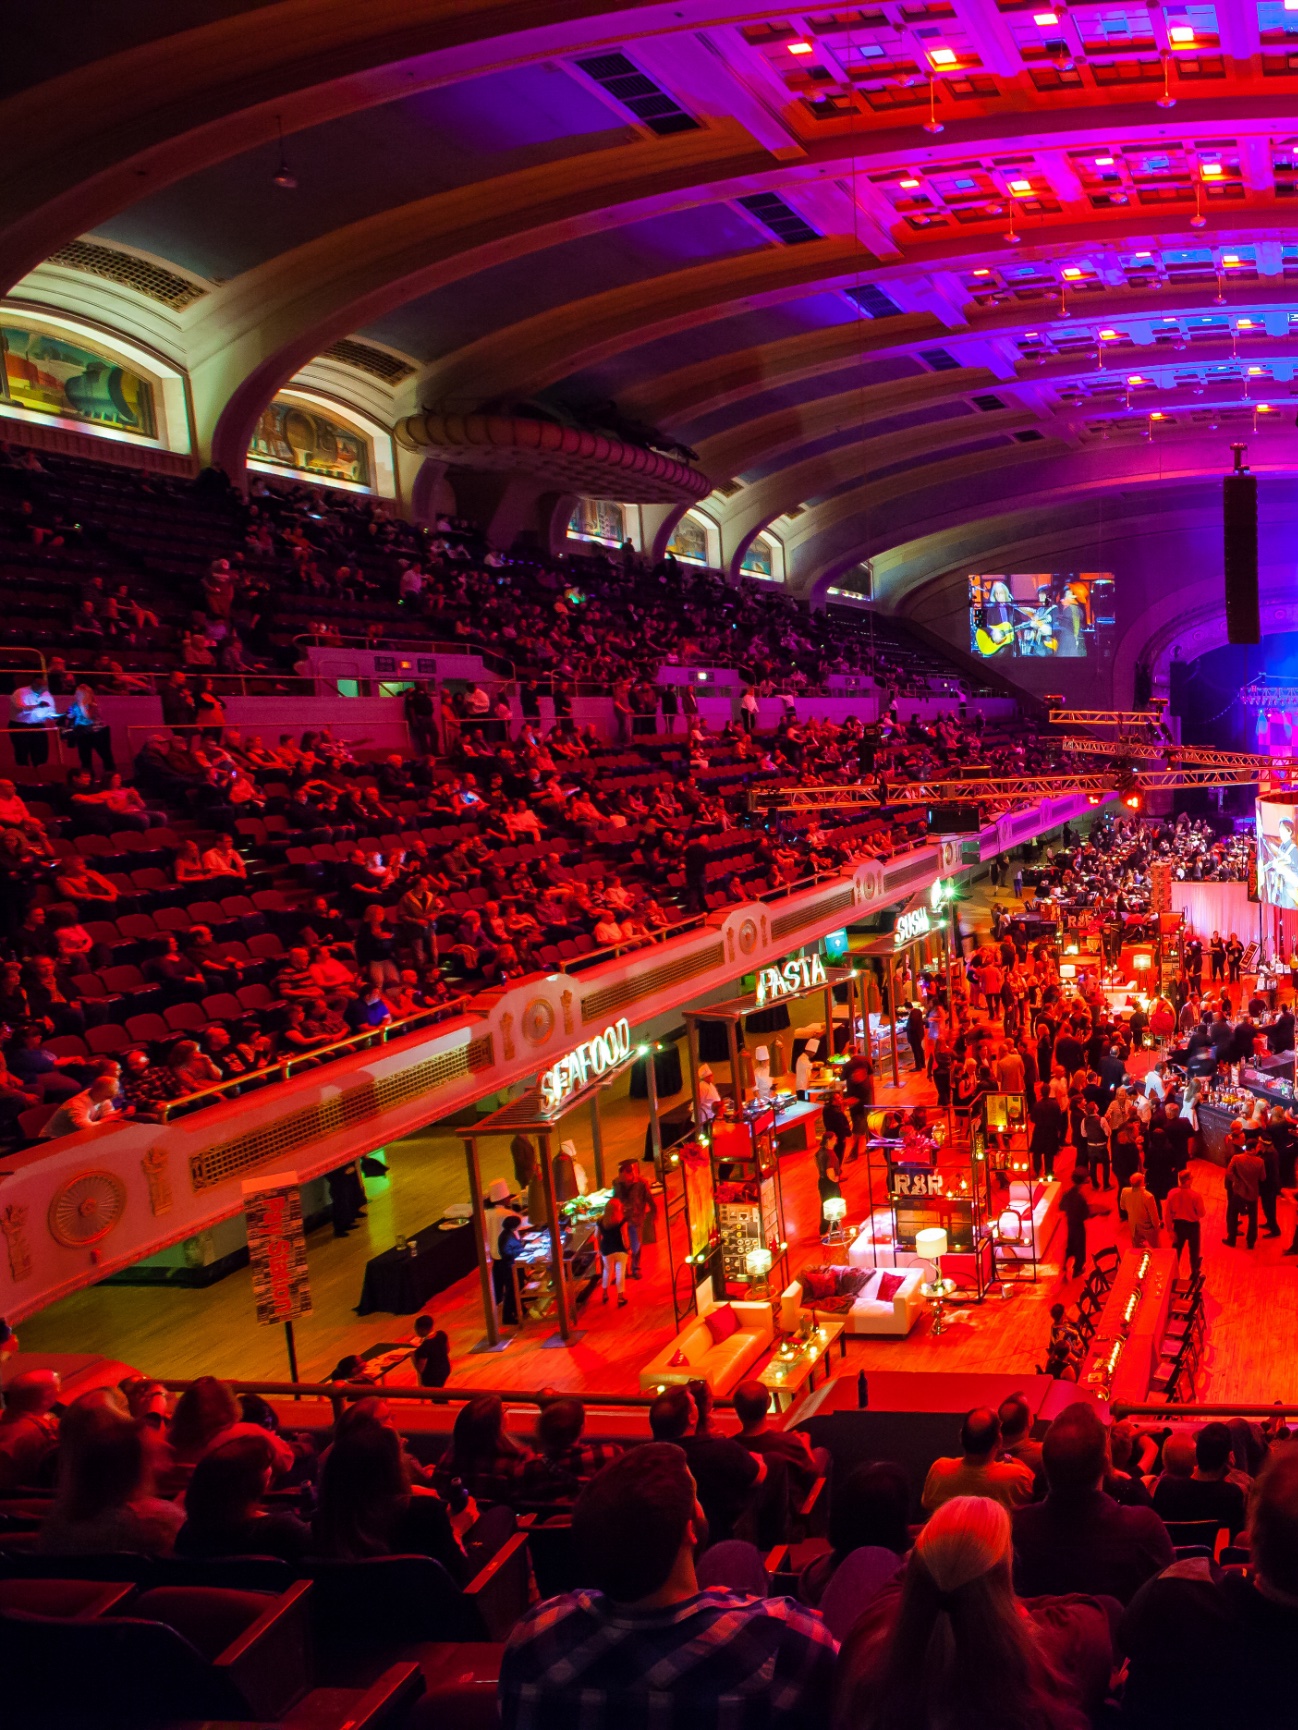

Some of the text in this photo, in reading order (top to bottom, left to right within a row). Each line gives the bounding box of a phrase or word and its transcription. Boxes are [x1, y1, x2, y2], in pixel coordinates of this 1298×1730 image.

[756, 954, 826, 1005] PASTA
[541, 1018, 630, 1110] SEAFOOD
[894, 1173, 943, 1195] R&R
[259, 1197, 294, 1313] Pay Station
